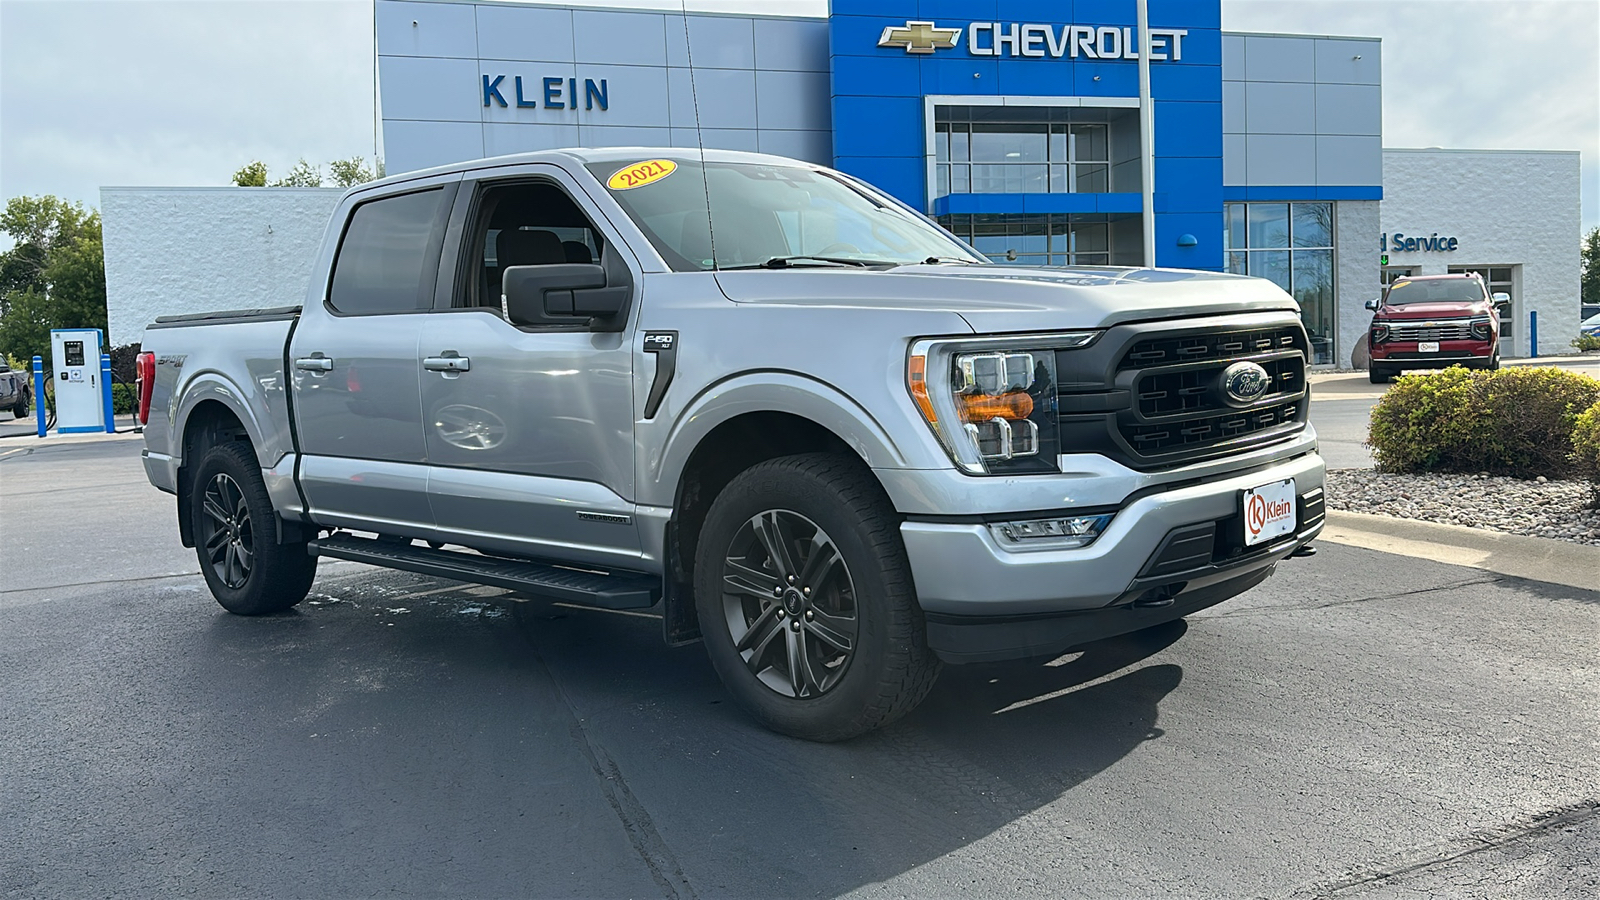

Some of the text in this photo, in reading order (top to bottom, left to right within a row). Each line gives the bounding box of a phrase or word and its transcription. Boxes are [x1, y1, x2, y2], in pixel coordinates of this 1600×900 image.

[968, 22, 1188, 61] CHEVROLET
[482, 74, 609, 111] KLEIN
[619, 160, 668, 187] 2021
[1393, 233, 1458, 251] Service
[157, 355, 188, 365] SPORT
[1238, 373, 1261, 394] Ford
[1267, 498, 1291, 519] Klein
